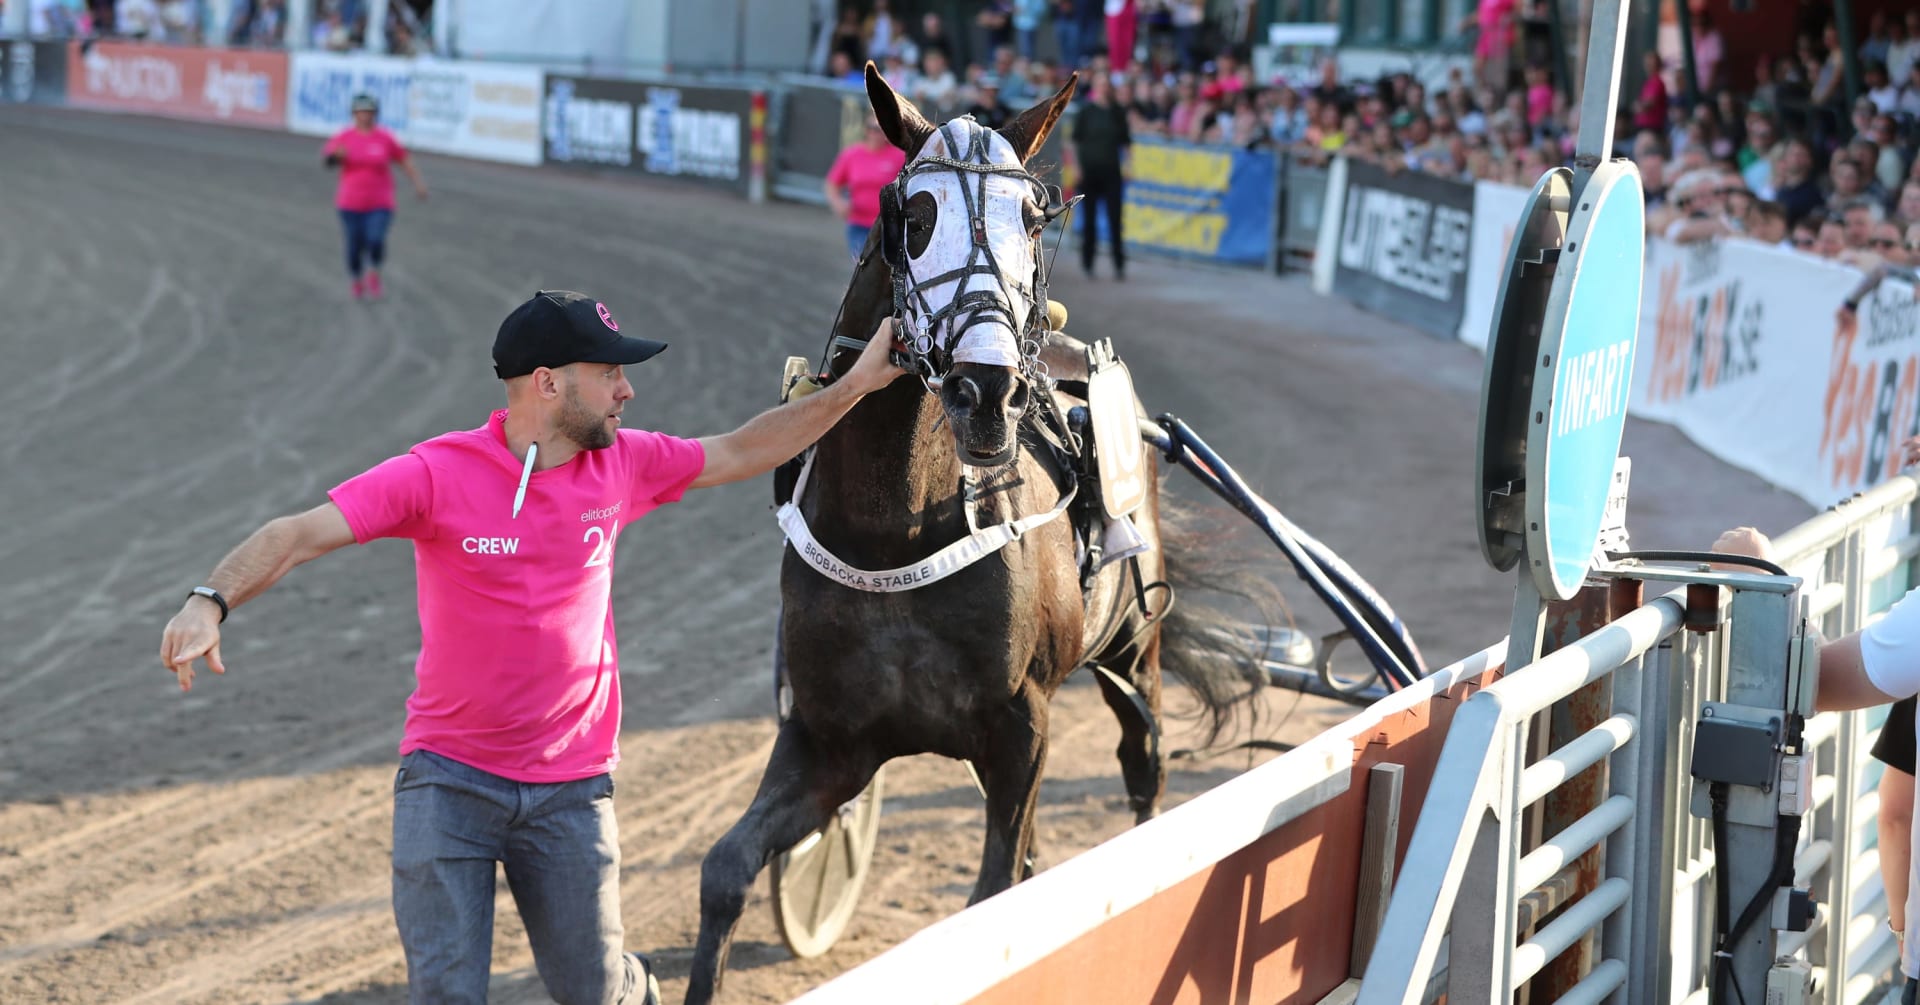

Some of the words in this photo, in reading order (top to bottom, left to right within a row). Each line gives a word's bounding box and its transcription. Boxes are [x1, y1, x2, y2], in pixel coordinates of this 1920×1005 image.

[1557, 340, 1631, 437] INFART
[462, 537, 520, 555] CREW
[804, 541, 867, 586] BROBACKA
[872, 566, 931, 588] STABLE
